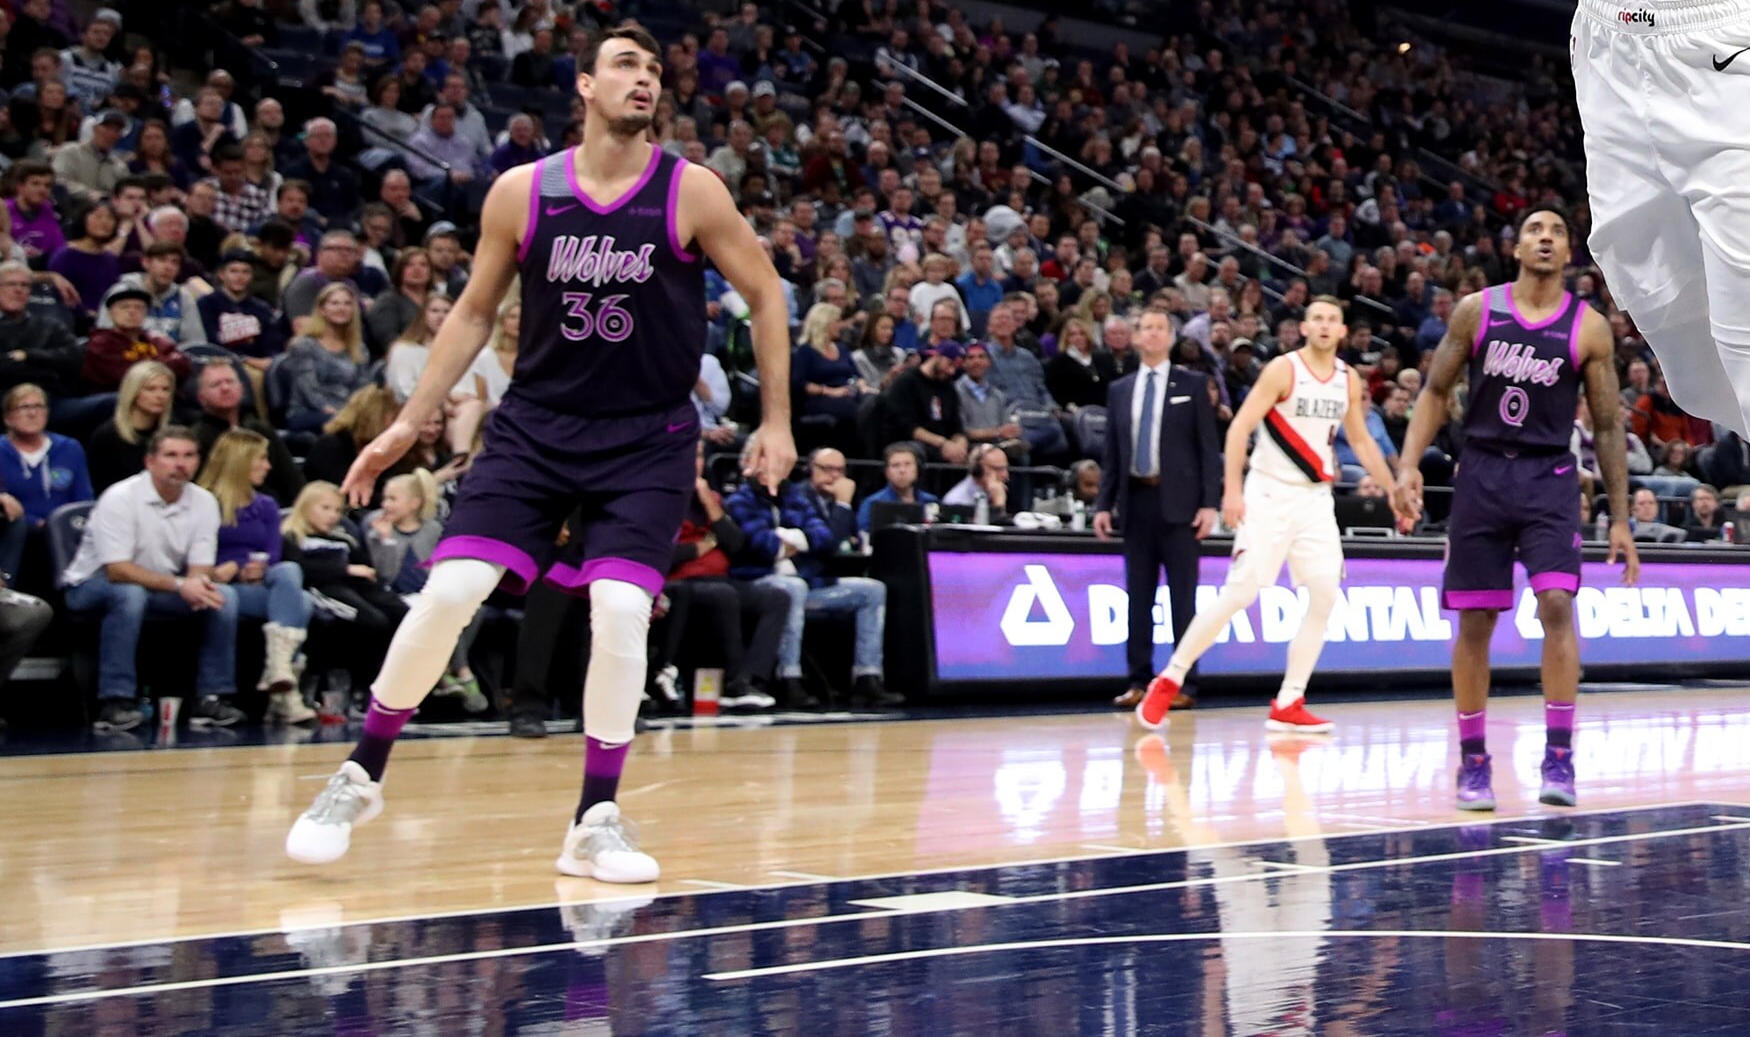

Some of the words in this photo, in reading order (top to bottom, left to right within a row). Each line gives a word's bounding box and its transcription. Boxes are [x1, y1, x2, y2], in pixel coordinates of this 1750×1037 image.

[546, 235, 657, 288] Wolves
[560, 291, 635, 343] 36
[1483, 340, 1565, 387] Wolves
[1499, 385, 1530, 428] 0
[1259, 585, 1452, 644] DNTAL
[1576, 587, 1695, 639] DELTA
